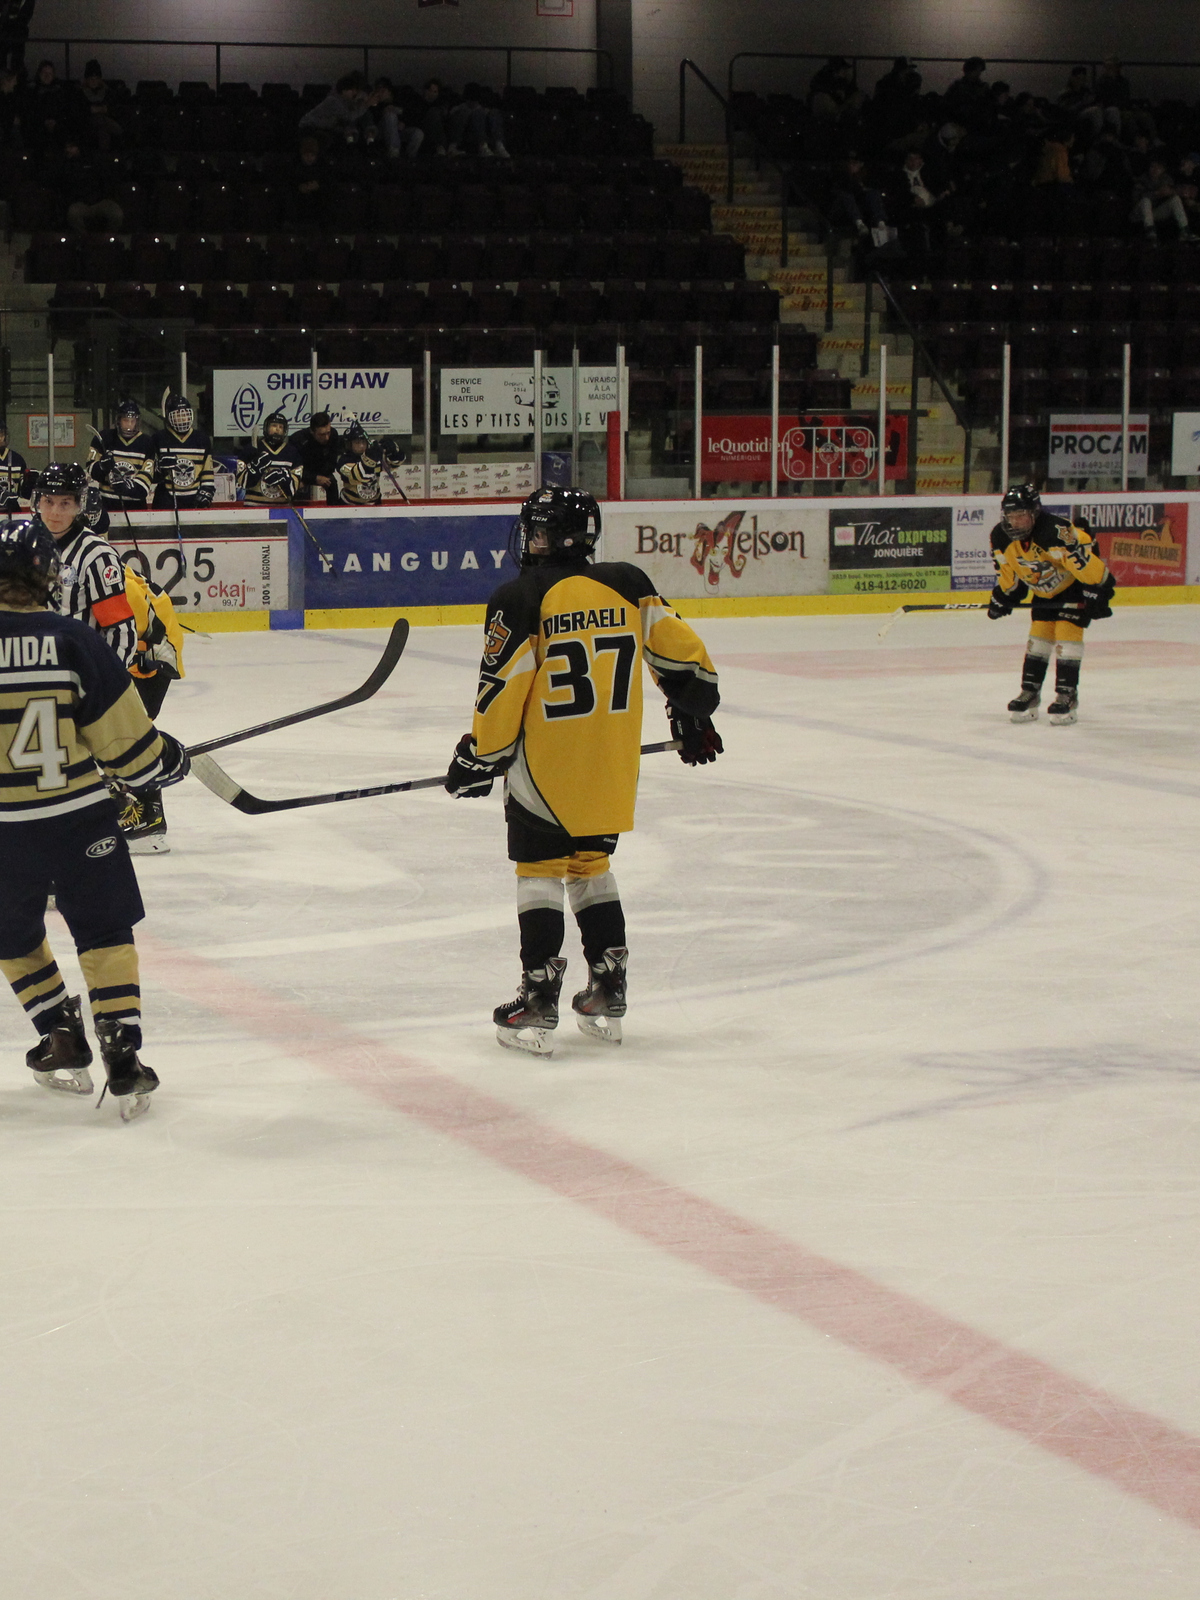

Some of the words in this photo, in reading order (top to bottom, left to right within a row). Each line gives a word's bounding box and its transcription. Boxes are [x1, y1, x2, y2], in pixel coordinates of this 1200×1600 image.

[583, 376, 617, 384] LIVRAISO
[444, 414, 469, 428] LES
[0, 529, 19, 543] 14
[635, 525, 687, 557] Bar
[898, 529, 948, 544] express
[873, 546, 924, 558] JONQUIÈRE
[954, 549, 987, 558] Jessica
[260, 544, 271, 581] RÉGIONAL
[318, 549, 507, 573] TANGUAY
[854, 579, 927, 591] 418-412-6020
[207, 579, 246, 608] ckaj
[542, 606, 627, 641] DISRAELI
[540, 631, 637, 722] 37
